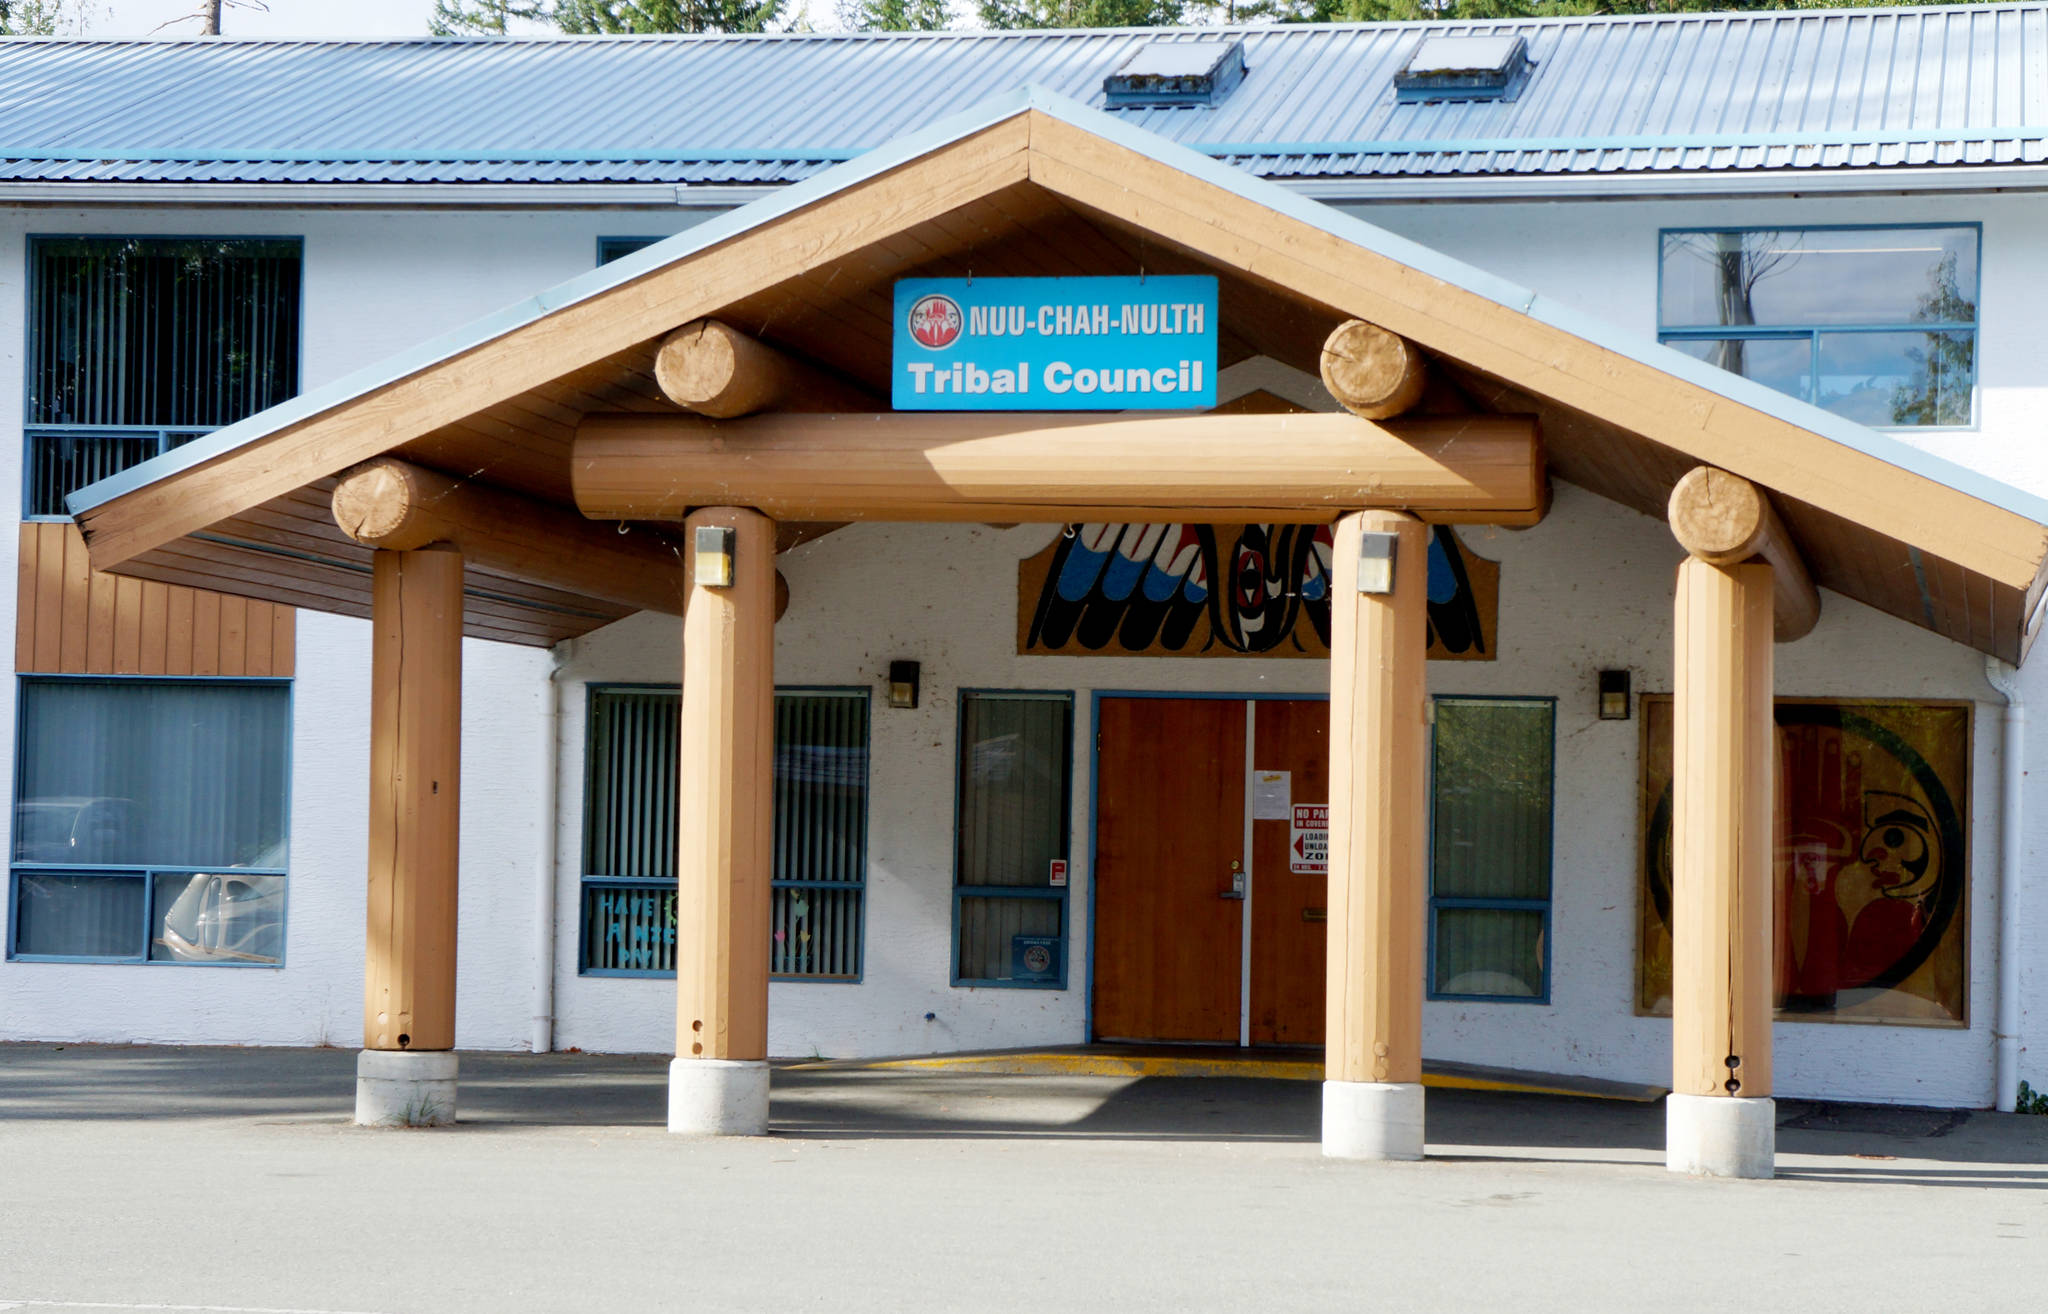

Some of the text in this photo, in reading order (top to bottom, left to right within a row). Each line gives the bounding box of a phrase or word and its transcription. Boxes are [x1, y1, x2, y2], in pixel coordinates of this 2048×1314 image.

[970, 304, 1205, 336] NUU-CHAH-NULTH
[907, 360, 1204, 394] Tribal Council
[1296, 808, 1309, 819] NO
[1304, 842, 1329, 850] UNLOA
[600, 895, 655, 917] HAVE
[606, 922, 621, 943] A
